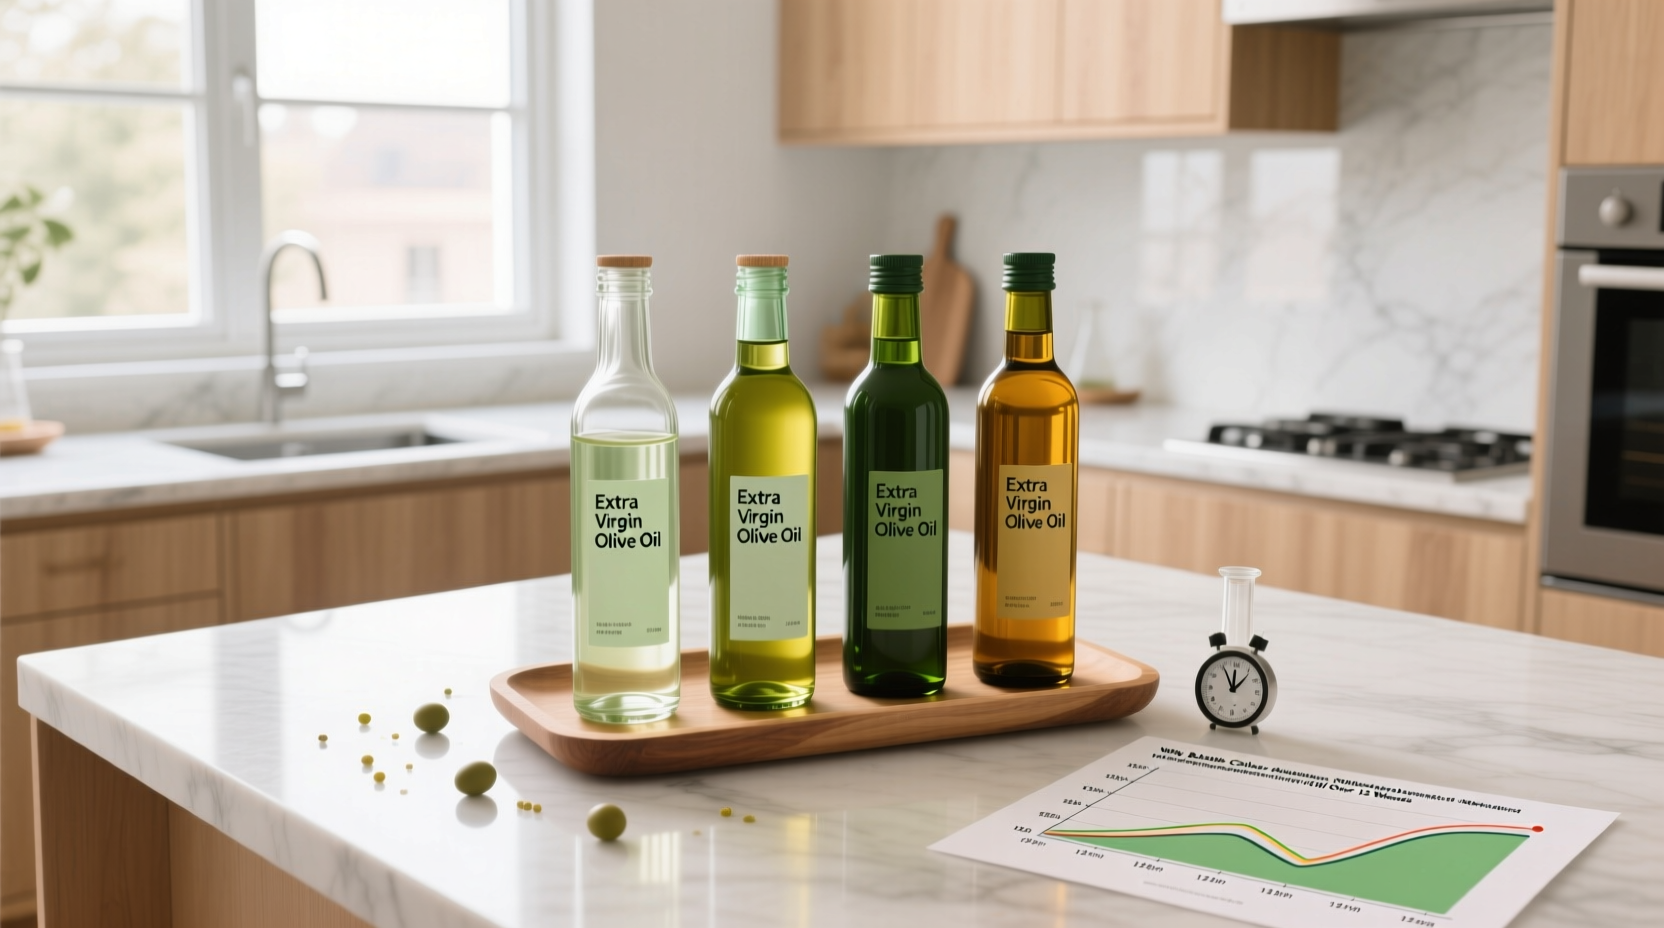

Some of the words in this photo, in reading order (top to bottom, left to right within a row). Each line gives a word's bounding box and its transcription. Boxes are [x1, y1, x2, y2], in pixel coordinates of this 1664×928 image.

[876, 483, 917, 499] Extra
[1006, 477, 1047, 492] Extra
[595, 494, 638, 510] Extra
[737, 489, 781, 505] Extra
[1005, 495, 1051, 514] Virgin
[737, 509, 784, 528] Virgin
[875, 503, 921, 522] Virgin
[1005, 514, 1043, 529] Olive
[1046, 513, 1066, 528] Oil
[595, 513, 642, 533] Virgin
[874, 521, 914, 537] Olive
[918, 520, 937, 537] Oil
[595, 532, 636, 549] Olive
[640, 531, 661, 548] Oil
[737, 528, 778, 544] Olive
[781, 526, 802, 543] Oil
